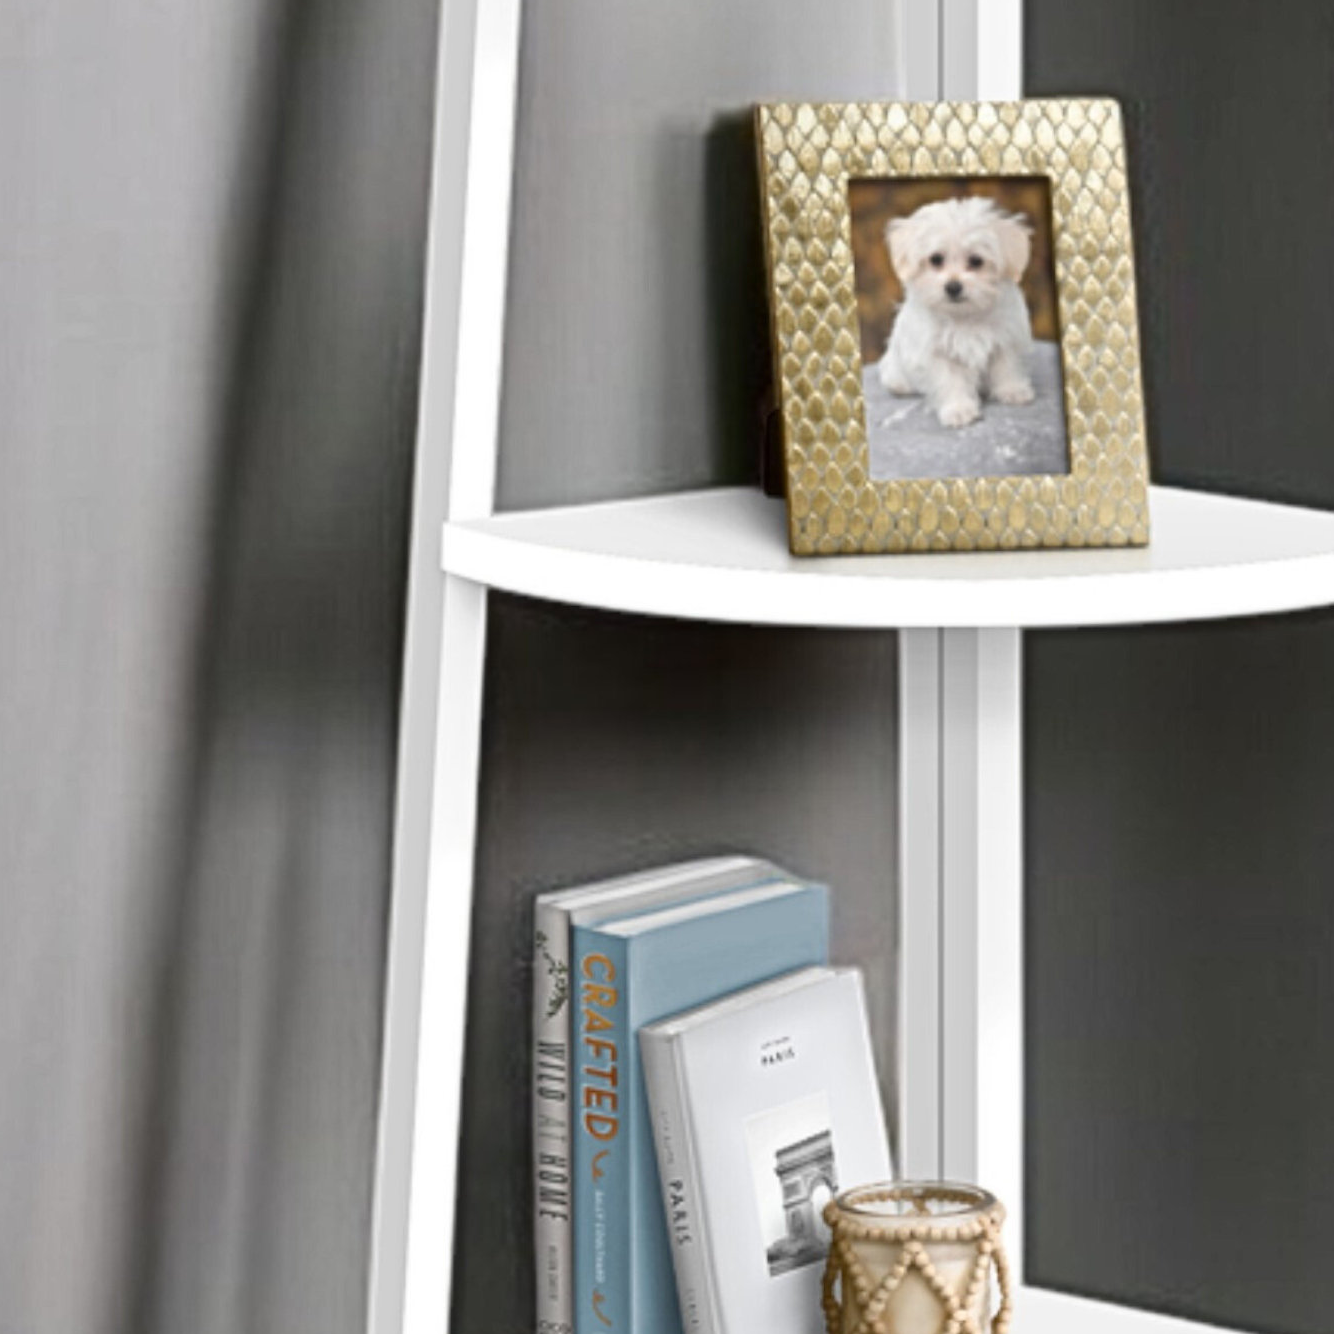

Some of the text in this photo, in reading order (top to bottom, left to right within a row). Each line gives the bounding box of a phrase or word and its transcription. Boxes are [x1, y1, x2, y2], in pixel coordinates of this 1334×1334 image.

[581, 952, 619, 1141] CRAFTED
[760, 1047, 795, 1066] PARIS
[537, 1040, 568, 1221] WILD AT HOME
[669, 1178, 693, 1246] PARIS
